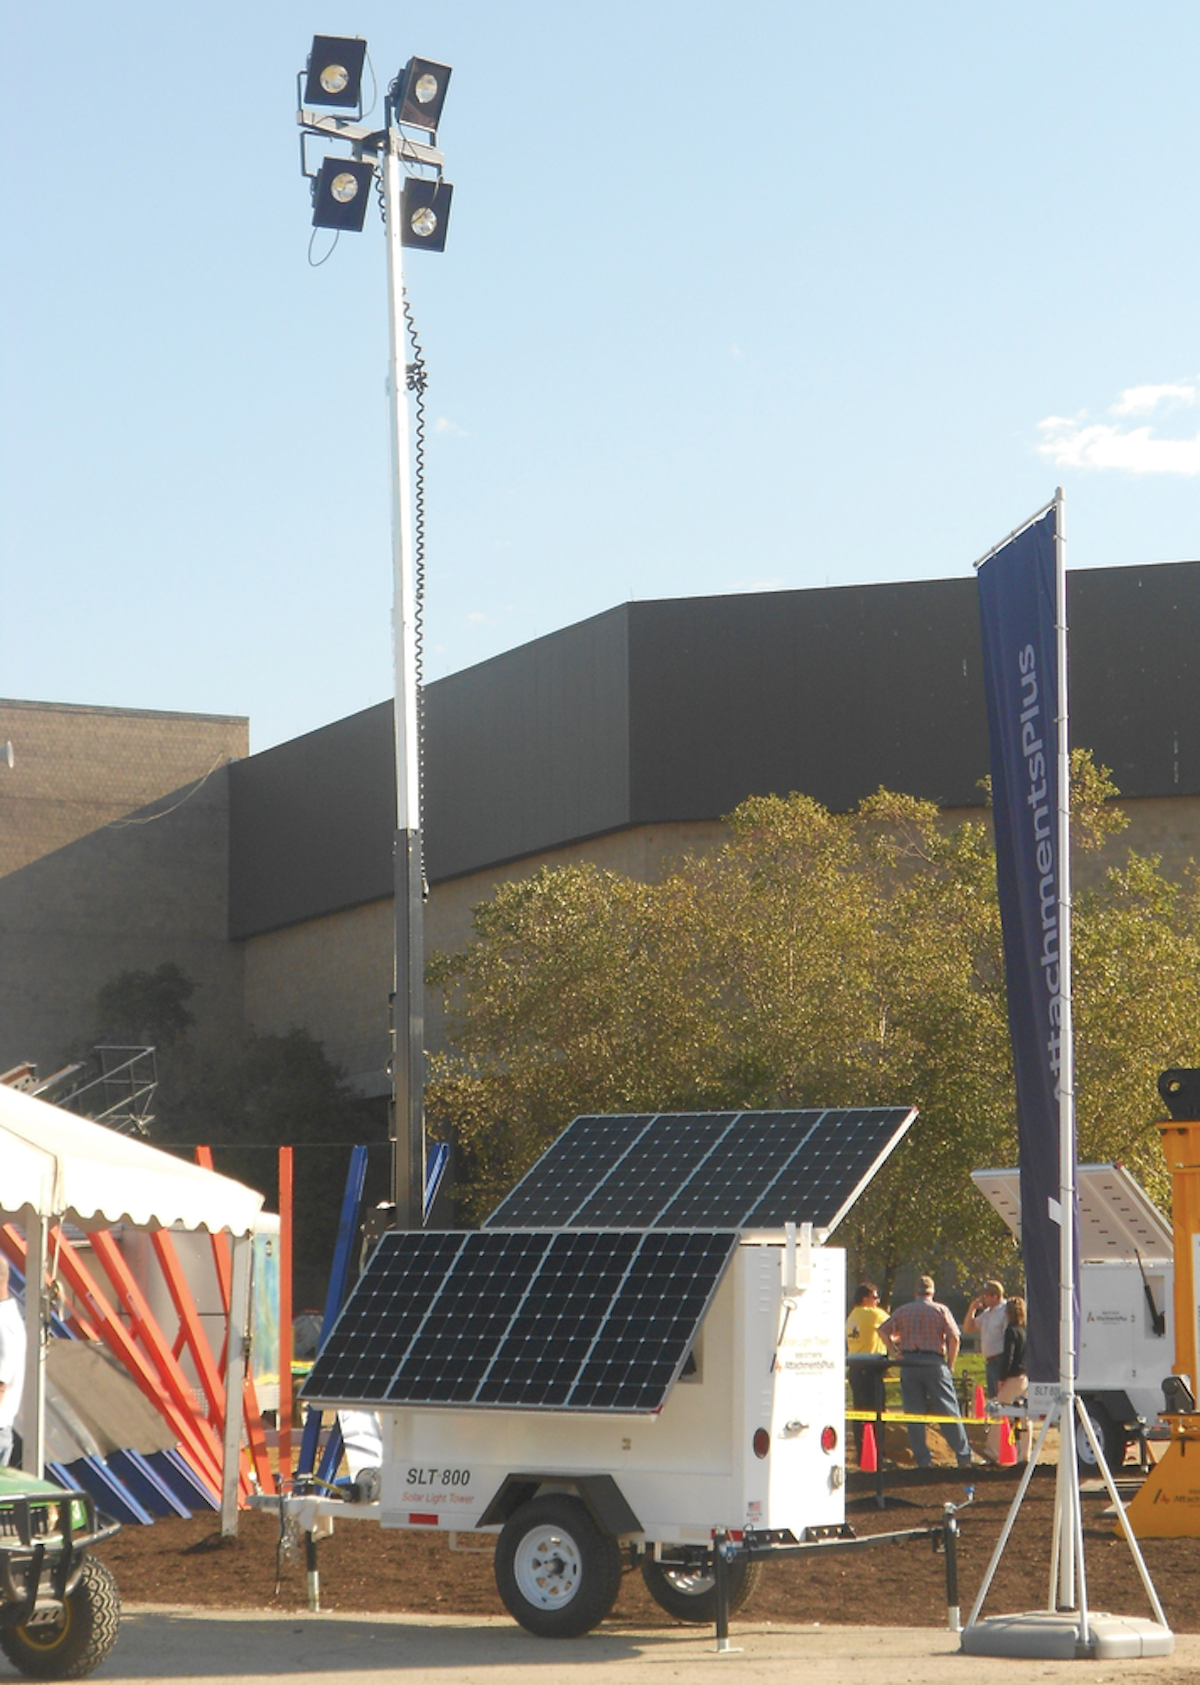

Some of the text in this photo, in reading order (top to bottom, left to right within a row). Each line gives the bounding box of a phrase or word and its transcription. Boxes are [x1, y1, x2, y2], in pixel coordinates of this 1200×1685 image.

[1034, 1386, 1061, 1396] SLT 80
[406, 1468, 471, 1486] SLT 800
[403, 1491, 475, 1505] Solar Light Tower
